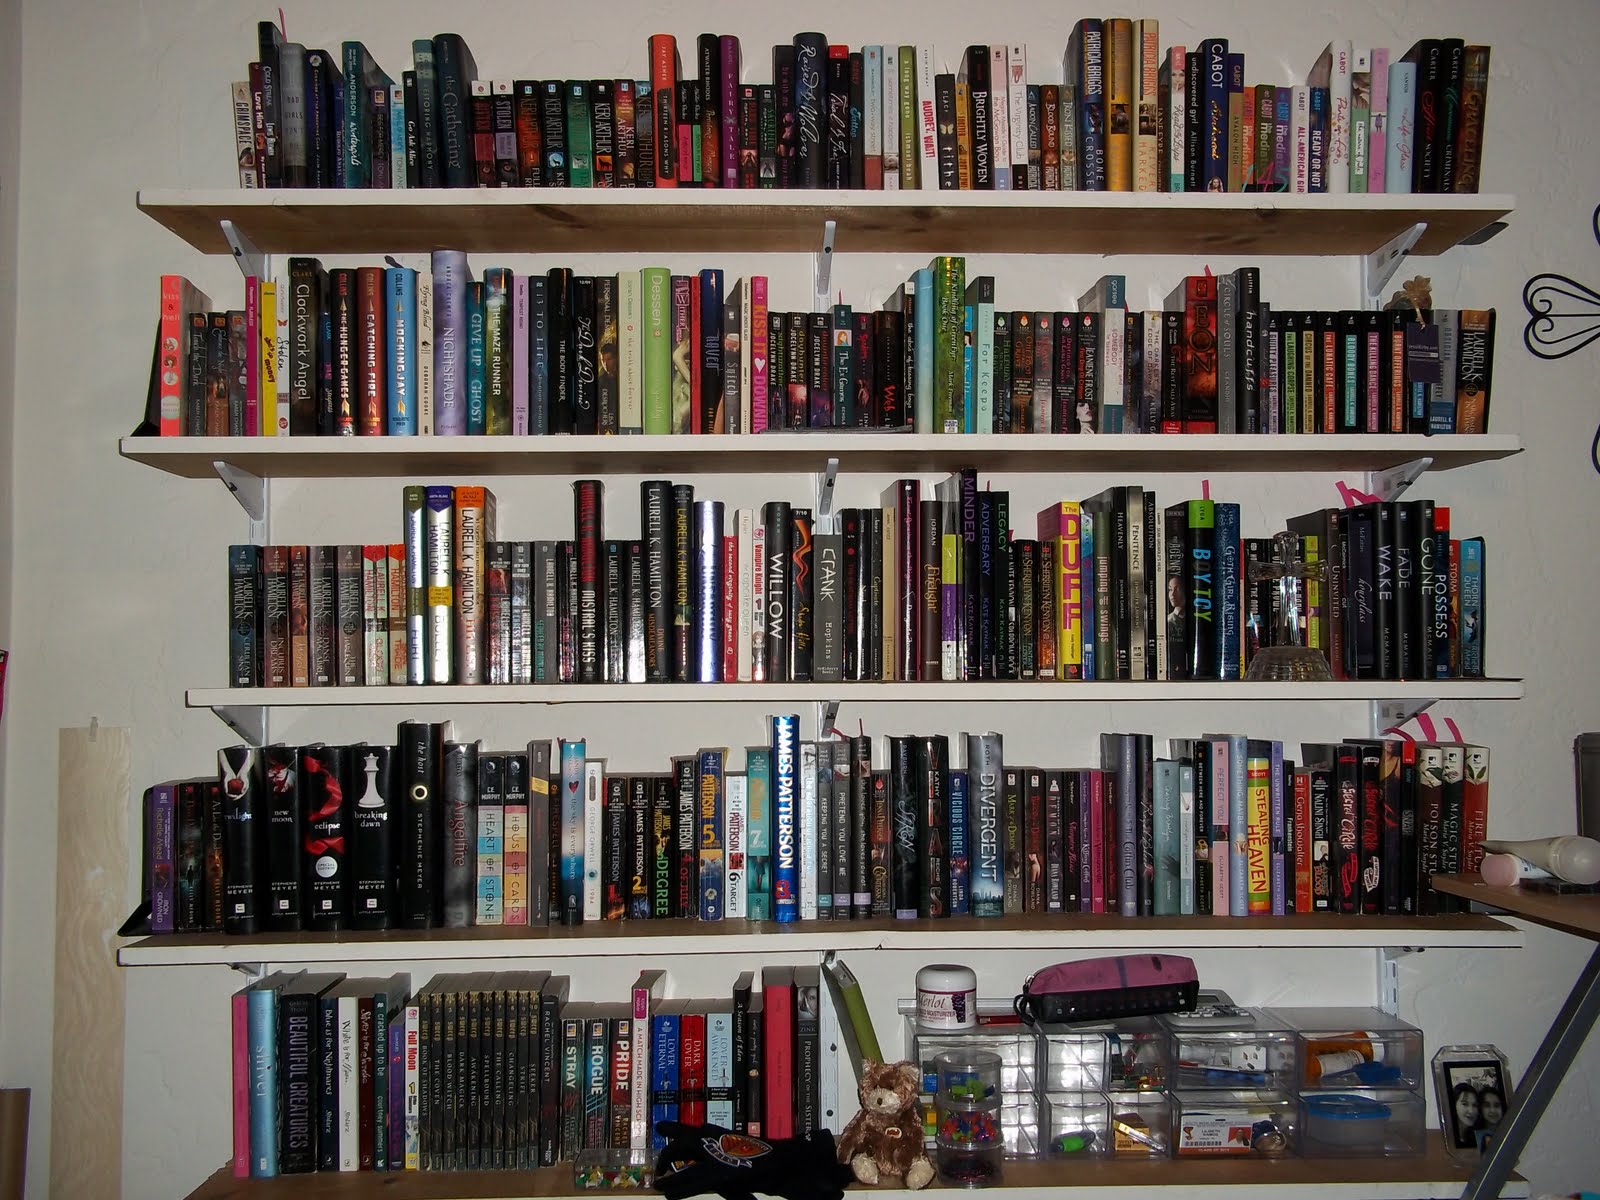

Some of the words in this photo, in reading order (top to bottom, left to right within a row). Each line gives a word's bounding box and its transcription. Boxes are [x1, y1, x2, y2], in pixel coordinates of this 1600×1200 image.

[1088, 31, 1101, 64] PATRICIA
[1143, 32, 1156, 64] PATRICIA
[1212, 44, 1223, 88] CABOT
[1429, 48, 1439, 80] CARTER
[1451, 48, 1461, 80] CARTER
[798, 44, 819, 90] Raised
[1088, 66, 1102, 94] BRIGGS
[1144, 66, 1157, 96] BRIGGS
[236, 102, 251, 144] GRIMSPACE
[442, 93, 461, 168] Gathering
[496, 101, 509, 129] STOLEN
[799, 104, 819, 158] Wolves
[972, 91, 987, 142] BRIGHTLY
[1012, 108, 1023, 139] Virginity
[1189, 109, 1199, 124] gyrl
[618, 118, 626, 157] ARTHUR
[626, 127, 634, 148] KERI
[1297, 127, 1305, 178] ALL-AMERICAN
[1311, 130, 1321, 156] READY
[942, 146, 955, 187] tithe
[976, 143, 988, 183] WOVEN
[1096, 150, 1104, 180] BONE
[1312, 158, 1321, 169] OR
[1312, 171, 1321, 187] NOT
[652, 276, 662, 326] Dessen
[1110, 280, 1118, 304] garsee
[296, 285, 310, 357] Clockwork
[471, 313, 482, 345] GIVE
[492, 307, 501, 325] THE
[753, 304, 766, 340] KISS
[277, 337, 288, 371] Stolen
[367, 314, 375, 367] CATCHING
[396, 319, 405, 395] MOCKINGJAY
[472, 349, 482, 366] UP
[492, 328, 501, 354] MAZE
[754, 342, 766, 356] IT
[838, 351, 848, 364] The
[982, 344, 990, 365] For
[1245, 311, 1257, 391] handcuffs
[1461, 333, 1474, 381] HAMILTON
[294, 361, 311, 400] Angel
[368, 373, 376, 396] FIRE
[492, 356, 501, 395] RUNNER
[558, 376, 566, 402] FINDER
[1085, 380, 1093, 401] FROST
[472, 379, 482, 424] GHOST
[648, 488, 661, 534] LAURELL
[677, 508, 687, 546] LAURELL
[964, 478, 975, 543] MINDER
[998, 504, 1006, 552] LEGACY
[461, 509, 474, 552] LAURELL
[649, 537, 661, 548] K.
[981, 502, 990, 576] ADVERSARY
[754, 544, 763, 572] Vampire
[1192, 549, 1211, 586] BOY
[1378, 545, 1392, 601] WAKE
[1398, 548, 1410, 589] FADE
[1420, 537, 1434, 596] GONE
[461, 567, 474, 614] HAMILTON
[649, 551, 662, 608] HAMILTON
[677, 561, 688, 606] HAMILTON
[754, 573, 763, 595] Knight
[769, 552, 784, 640] WILLOW
[1449, 562, 1457, 593] STORM
[234, 579, 244, 619] HAMILTON
[581, 590, 595, 639] MISTRAL'S
[1192, 588, 1211, 622] TOY
[1354, 578, 1372, 624] hourglass
[1435, 574, 1447, 639] POSSESS
[417, 741, 425, 755] the
[417, 757, 426, 774] host
[778, 724, 793, 774] JAMES
[679, 790, 692, 812] JAMES
[838, 792, 846, 823] PRETEND
[952, 792, 963, 824] VICIOUS
[1256, 788, 1269, 845] STEALING
[1314, 793, 1324, 817] NALINI
[156, 808, 164, 836] Richelle
[448, 800, 469, 866] Angelfire
[486, 813, 495, 850] HEART
[636, 810, 644, 832] JAMES
[679, 813, 693, 850] PATTERSON
[729, 812, 739, 851] PATTERSON
[778, 776, 793, 868] PATTERSON
[980, 773, 997, 882] DIVERGENT
[1314, 818, 1324, 839] SINGH
[1429, 803, 1438, 848] POISON
[1448, 803, 1458, 842] MAGIC
[1474, 810, 1484, 837] FIRE
[636, 834, 644, 876] PATTERSON
[952, 826, 963, 854] CIRCLE
[1247, 825, 1267, 892] HEAVEN
[656, 859, 669, 916] DEGREE
[839, 867, 846, 877] ME
[485, 879, 495, 920] STONE
[377, 1013, 385, 1041] cracked
[408, 1031, 417, 1045] Full
[289, 1016, 308, 1078] BEAUTIFUL
[375, 1044, 383, 1054] up
[377, 1056, 384, 1065] to
[408, 1047, 418, 1070] Moon
[616, 1040, 629, 1090] PRIDE
[658, 1033, 667, 1071] ETERNAL
[667, 1038, 676, 1066] LOVER
[684, 1038, 693, 1068] LOVER
[693, 1040, 701, 1064] DARK
[720, 1037, 728, 1067] LOVER
[804, 1040, 812, 1082] PROPHECY
[377, 1067, 385, 1077] be
[566, 1046, 576, 1089] STRAY
[591, 1045, 603, 1095] ROGUE
[289, 1082, 309, 1148] CREATURES
[376, 1095, 384, 1123] courtney
